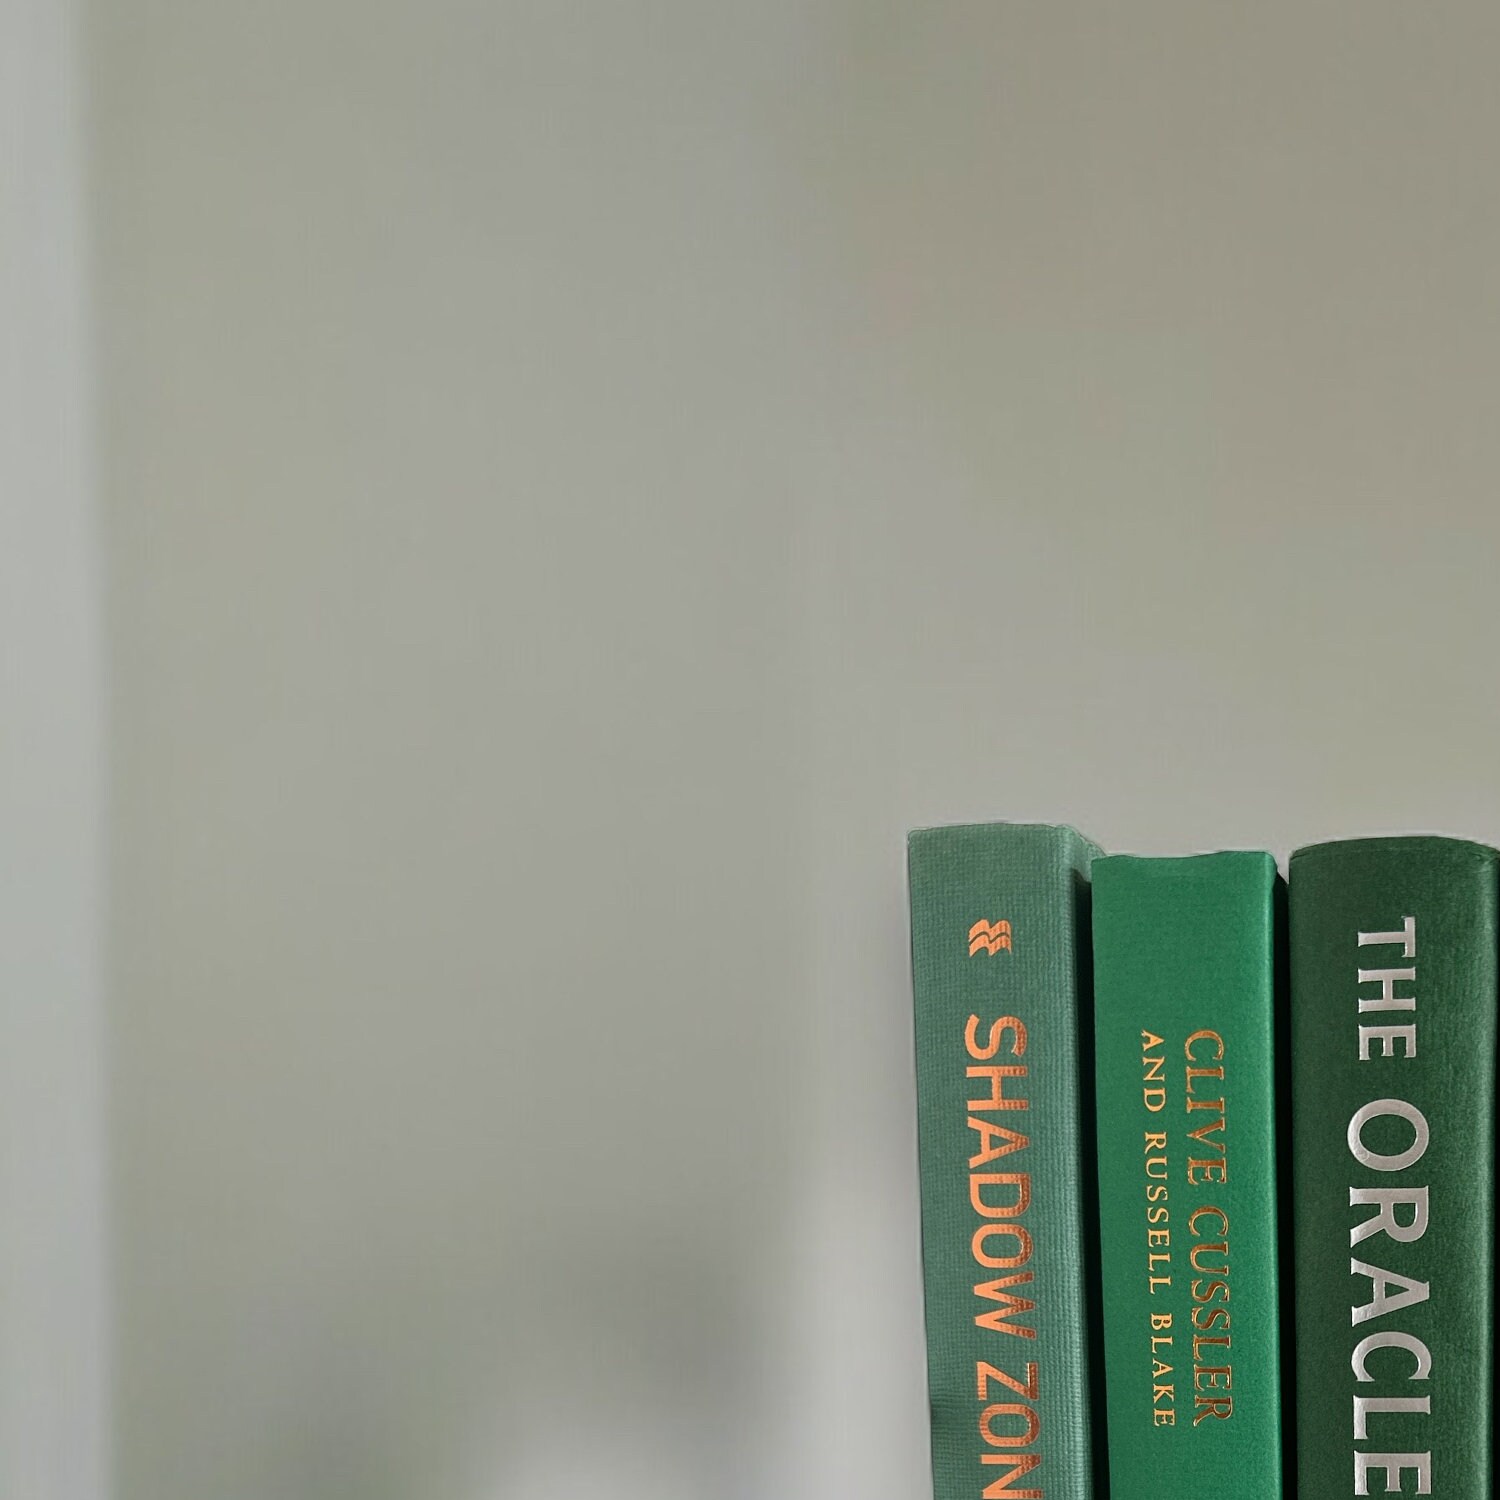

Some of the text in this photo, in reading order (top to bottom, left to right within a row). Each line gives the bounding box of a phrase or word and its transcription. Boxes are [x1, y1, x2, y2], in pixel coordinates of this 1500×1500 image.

[964, 1014, 1037, 1341] SHADOW
[1141, 1030, 1176, 1427] AND RUSSELL BLAKE
[1184, 1030, 1234, 1427] CLIVE CUSSLER
[1346, 915, 1432, 1495] THE ORACLE
